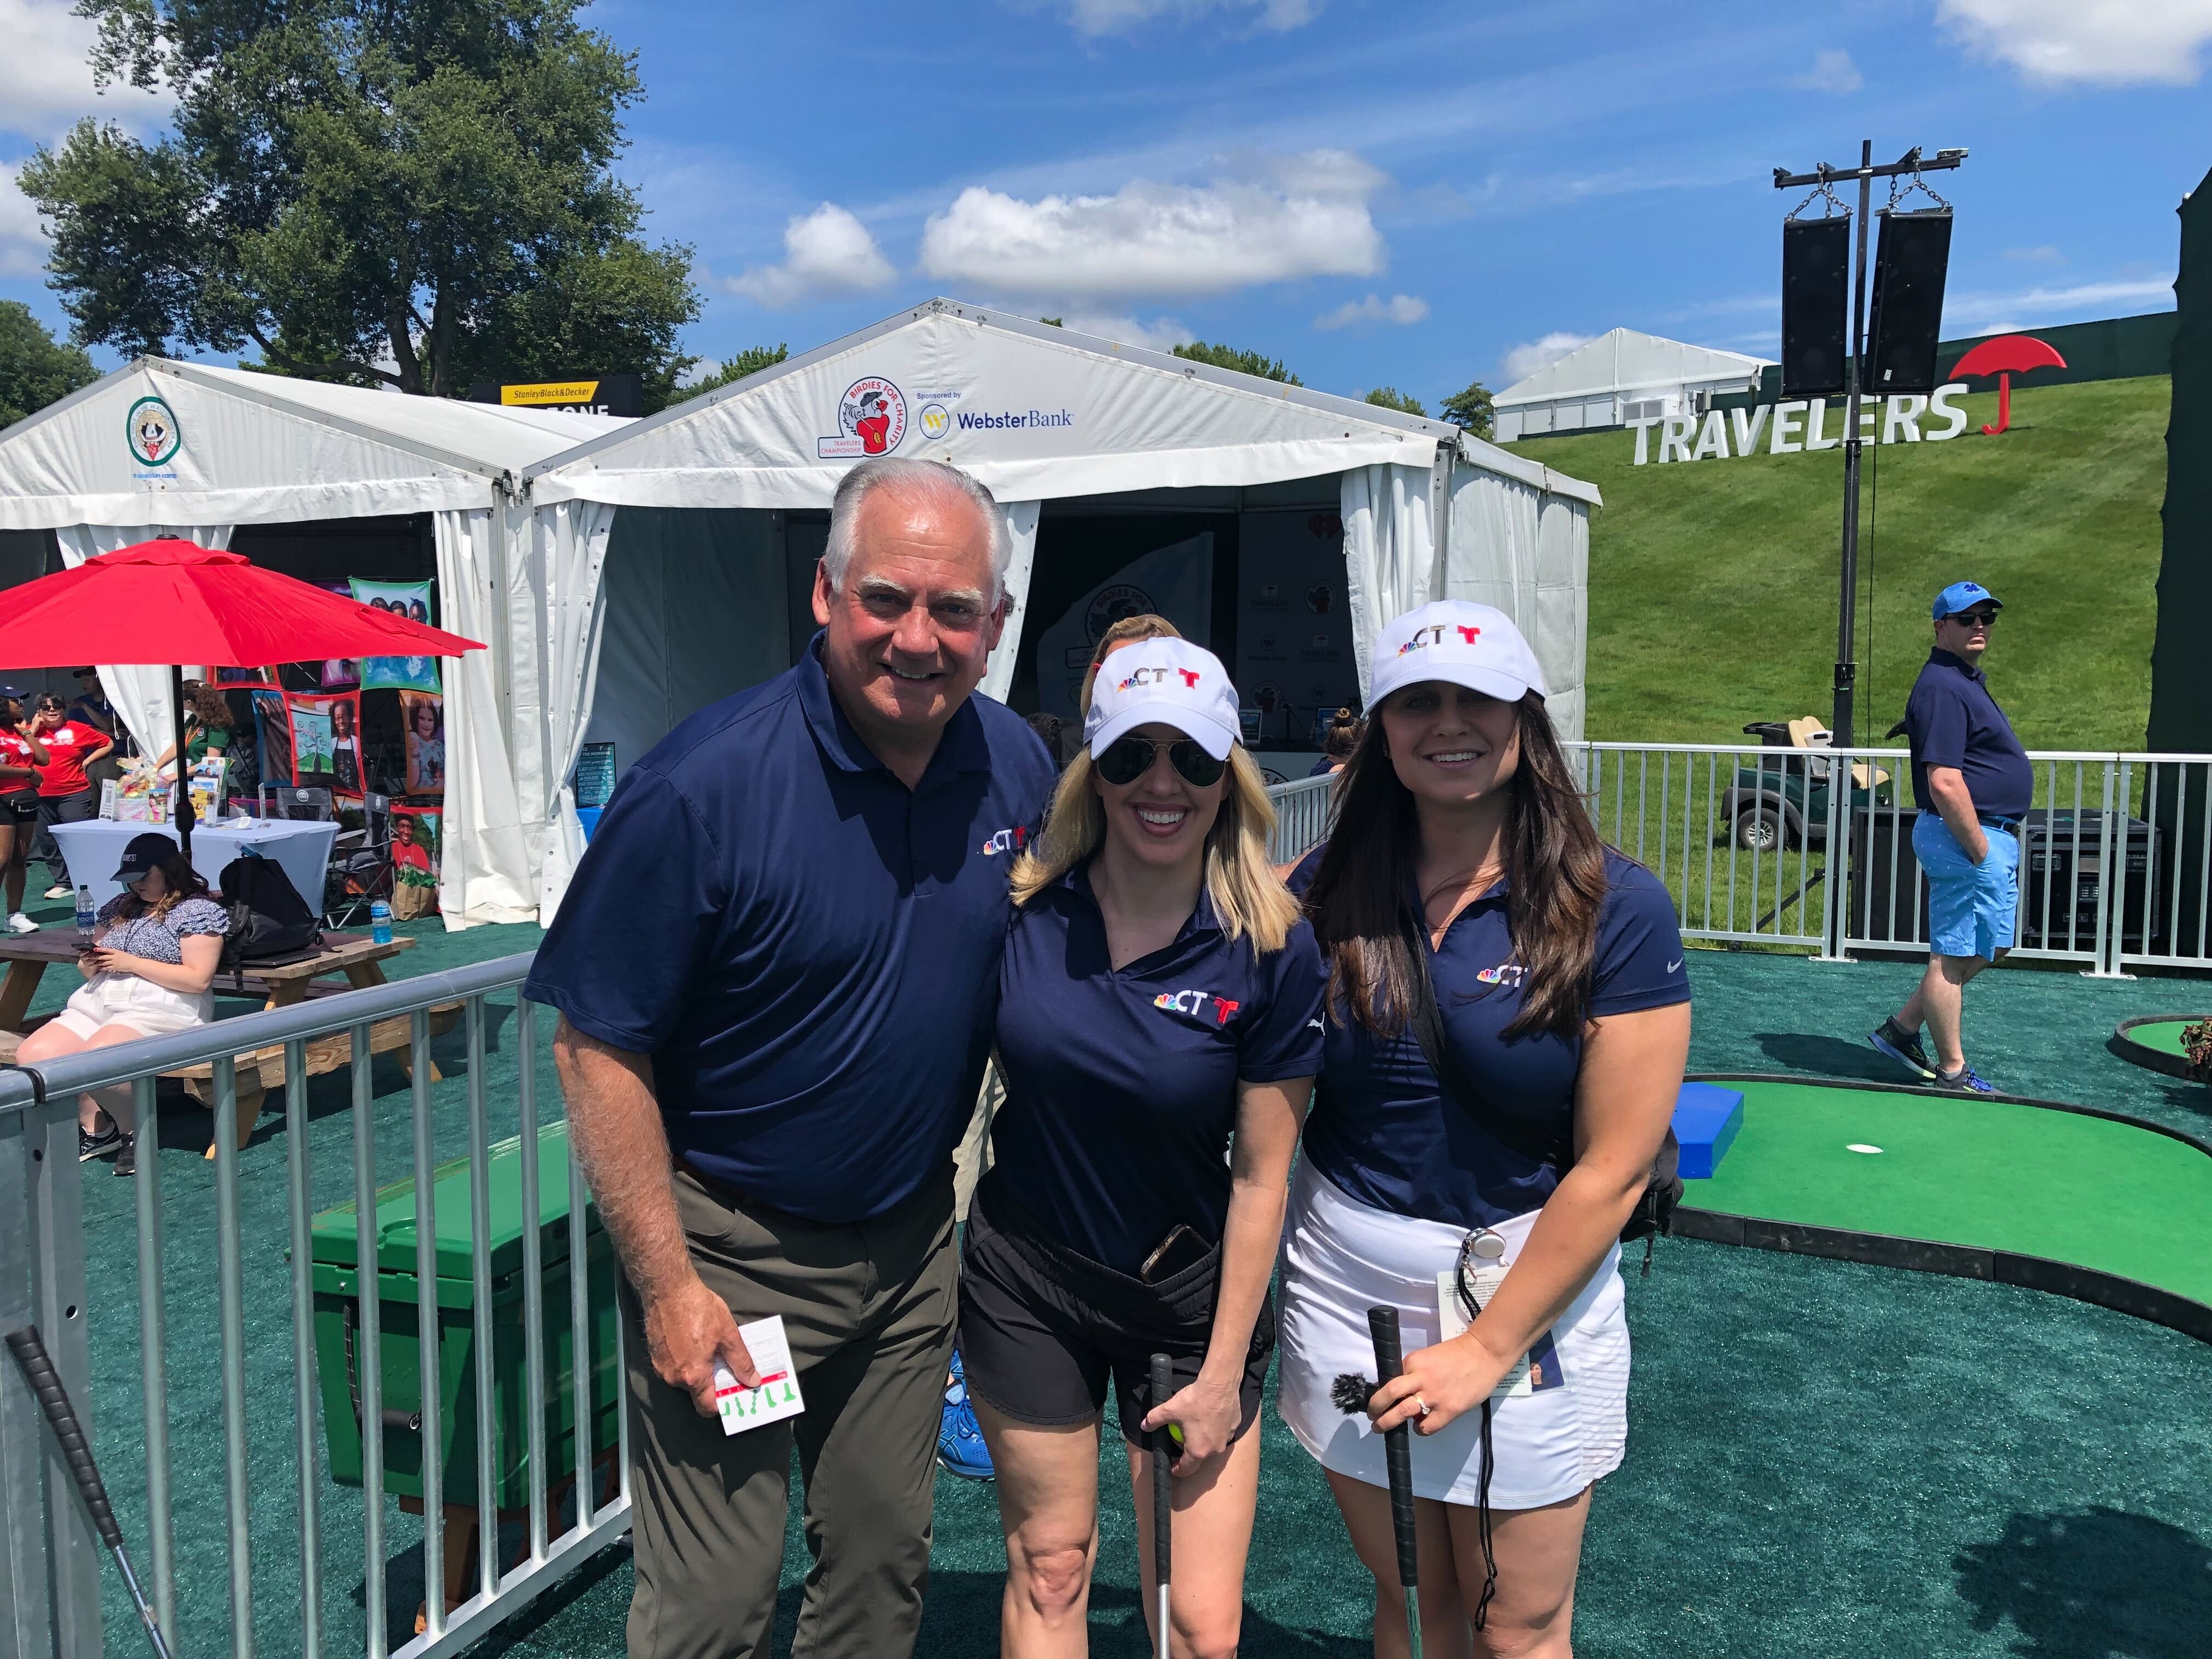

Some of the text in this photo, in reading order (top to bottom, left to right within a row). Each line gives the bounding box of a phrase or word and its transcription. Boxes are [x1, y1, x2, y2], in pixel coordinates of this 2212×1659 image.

[514, 387, 590, 399] StanleyBlack&Decker
[917, 392, 951, 400] Sponsored
[547, 405, 608, 416] NE
[850, 381, 904, 445] BIRDIES FOR CHARITY
[150, 404, 165, 414] WALL
[167, 431, 175, 448] CAMP
[1625, 382, 1969, 466] TRAVELERS
[993, 828, 1012, 851] CT
[1174, 990, 1208, 1015] CT
